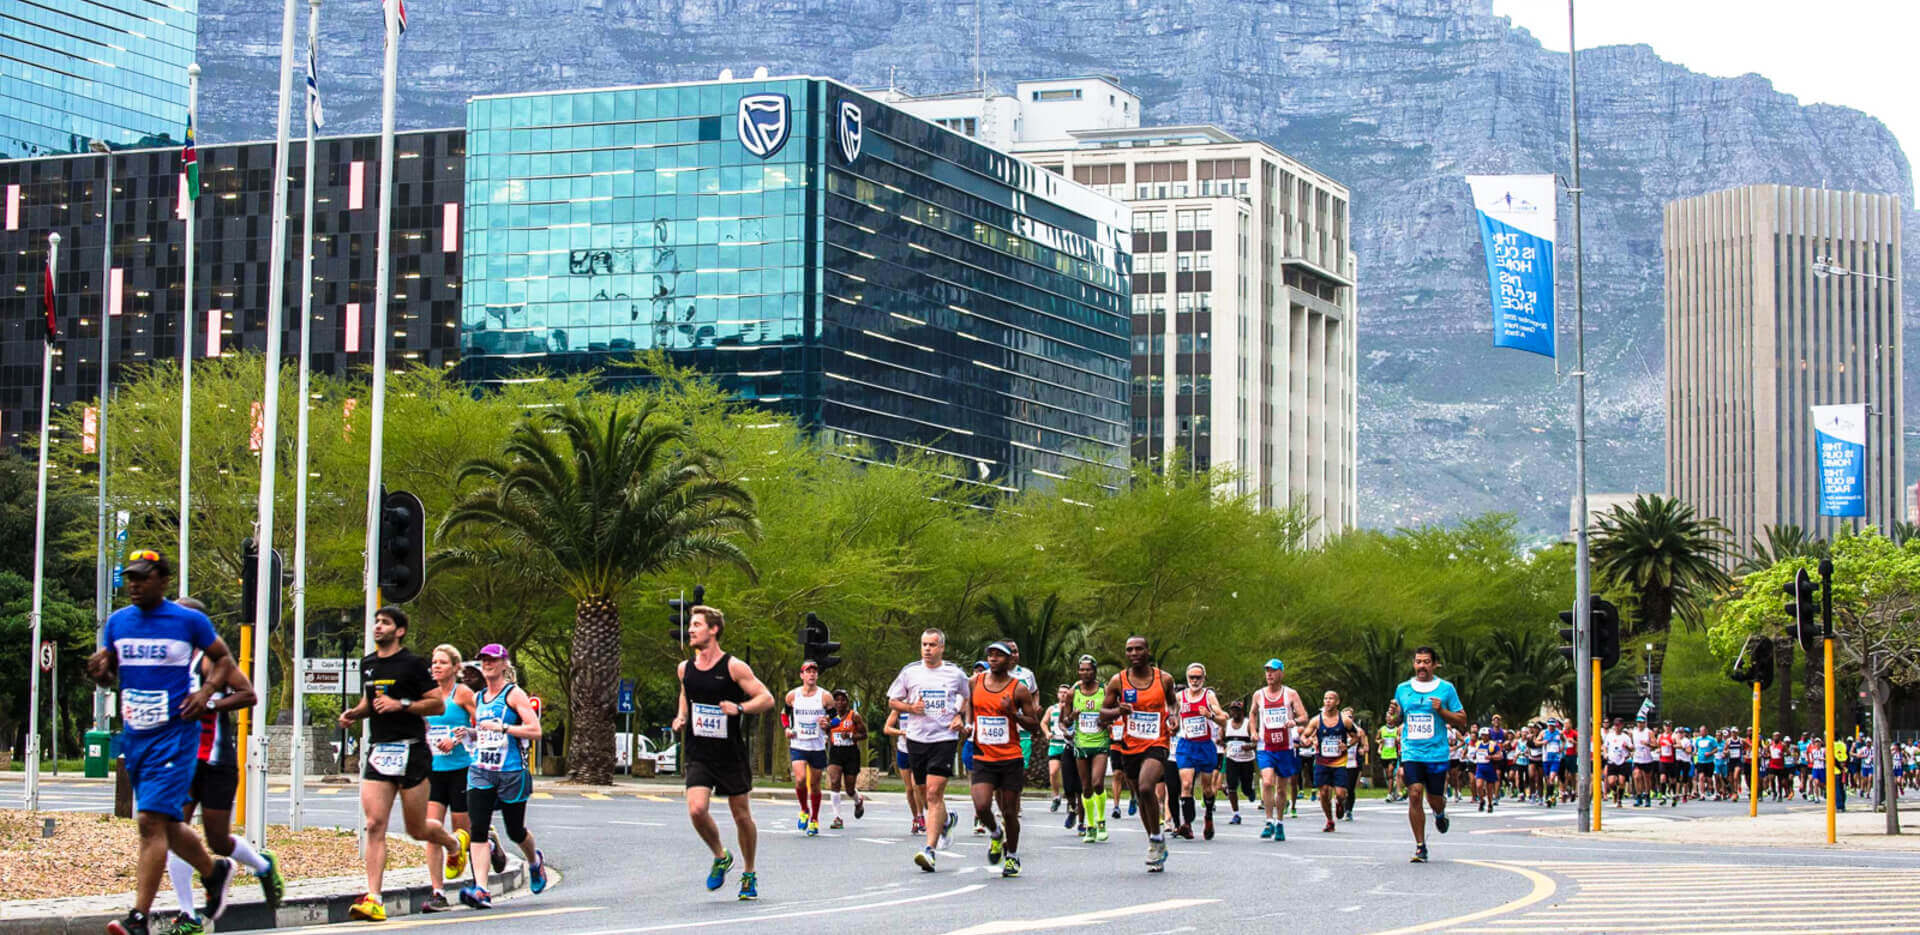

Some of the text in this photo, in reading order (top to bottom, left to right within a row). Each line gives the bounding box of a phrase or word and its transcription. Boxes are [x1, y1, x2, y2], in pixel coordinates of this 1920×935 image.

[122, 644, 168, 659] ELSIES
[696, 716, 721, 729] A441
[1129, 721, 1158, 734] B1122
[981, 726, 1004, 738] A460
